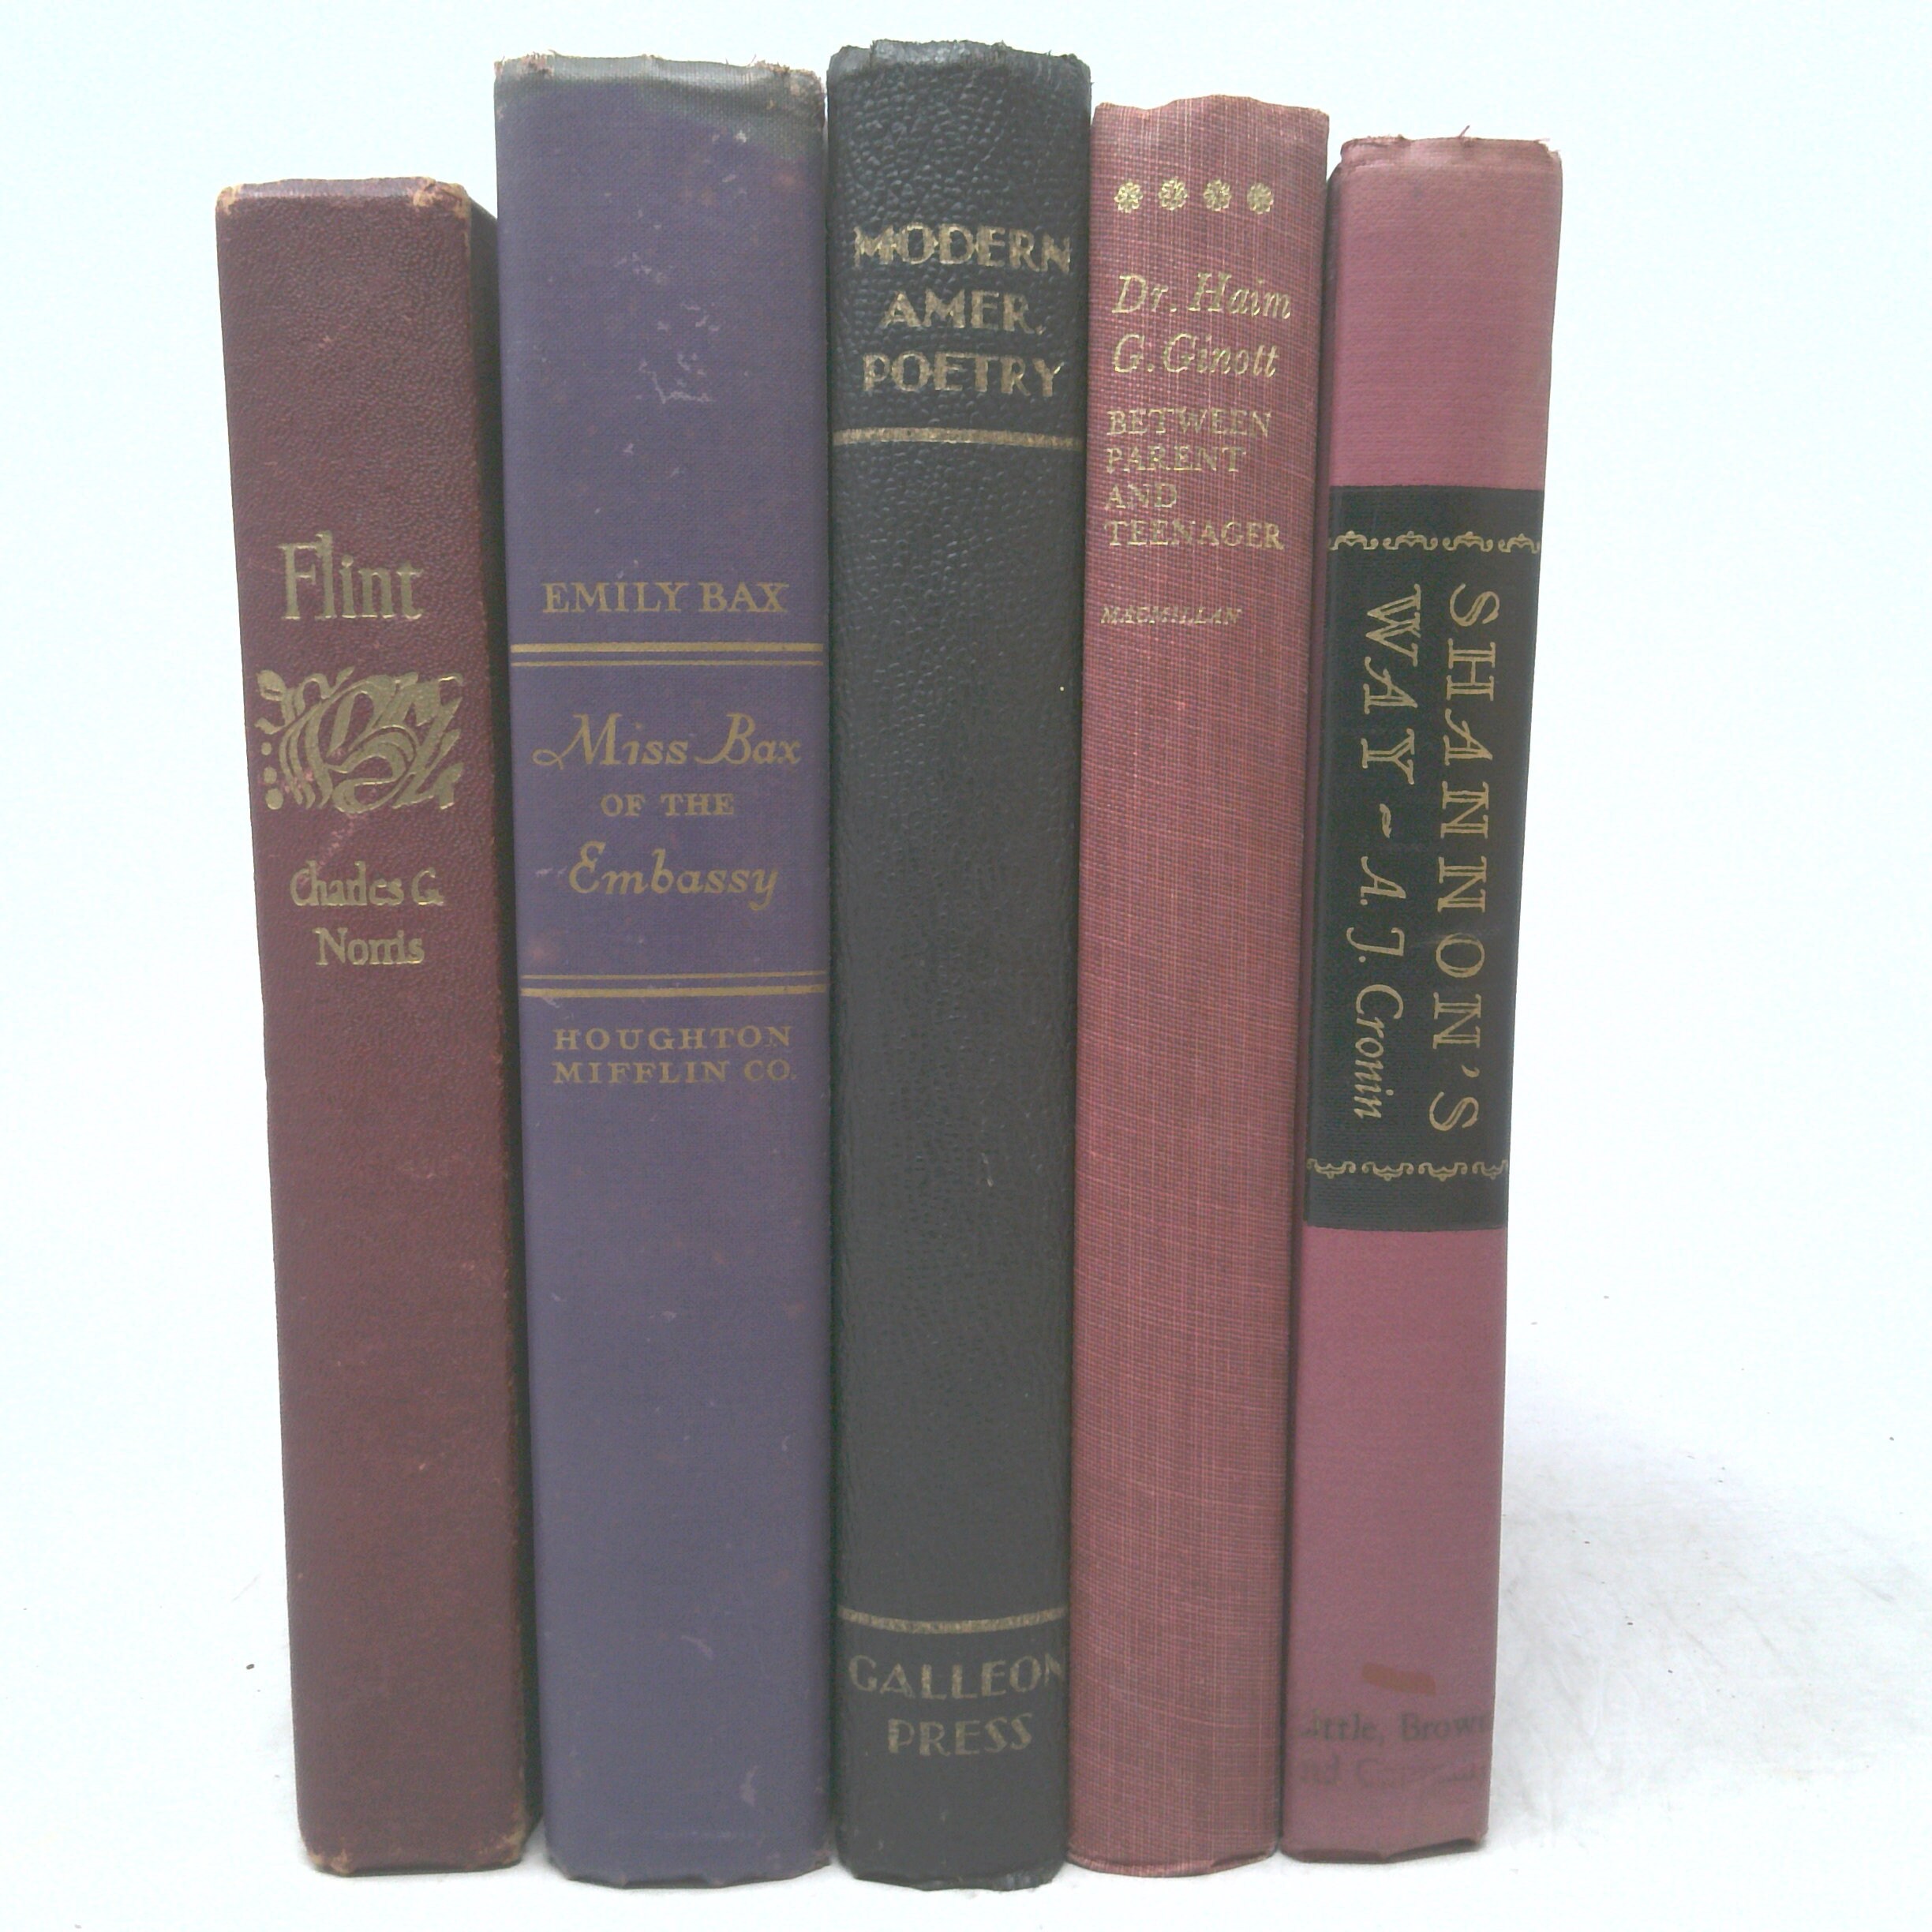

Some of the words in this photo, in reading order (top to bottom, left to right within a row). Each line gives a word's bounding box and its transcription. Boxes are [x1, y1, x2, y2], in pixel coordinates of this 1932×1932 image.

[853, 222, 1071, 274] MODERN
[878, 289, 1046, 335] AMER.
[1111, 273, 1178, 314] Dr.
[1188, 271, 1291, 320] Haim
[863, 350, 1065, 398] POETRY
[1113, 333, 1155, 373] G.
[1163, 332, 1280, 377] Ginott
[1106, 406, 1272, 438] BETWEEN
[1106, 445, 1247, 474] PARENT
[1105, 483, 1178, 511] AND
[1105, 519, 1285, 550] TEENAGER
[279, 530, 425, 620] Flint
[542, 581, 684, 613] EMILY
[698, 581, 790, 613] BAX
[1360, 582, 1421, 785] WAY
[532, 712, 689, 770] Miss
[693, 712, 802, 766] Bax
[600, 792, 646, 818] OF
[661, 792, 736, 817] THE
[568, 840, 780, 912] Embassy
[1428, 582, 1500, 1132] SHANNON'S
[289, 859, 405, 907] Charles
[312, 926, 425, 966] Norris
[552, 1025, 791, 1051] HOUGHTON
[1353, 983, 1405, 1119] Cronin
[552, 1060, 730, 1084] MIFFLIN
[743, 1058, 797, 1083] CO.
[848, 1653, 1064, 1699] GALLEON
[888, 1713, 1033, 1757] PRESS
